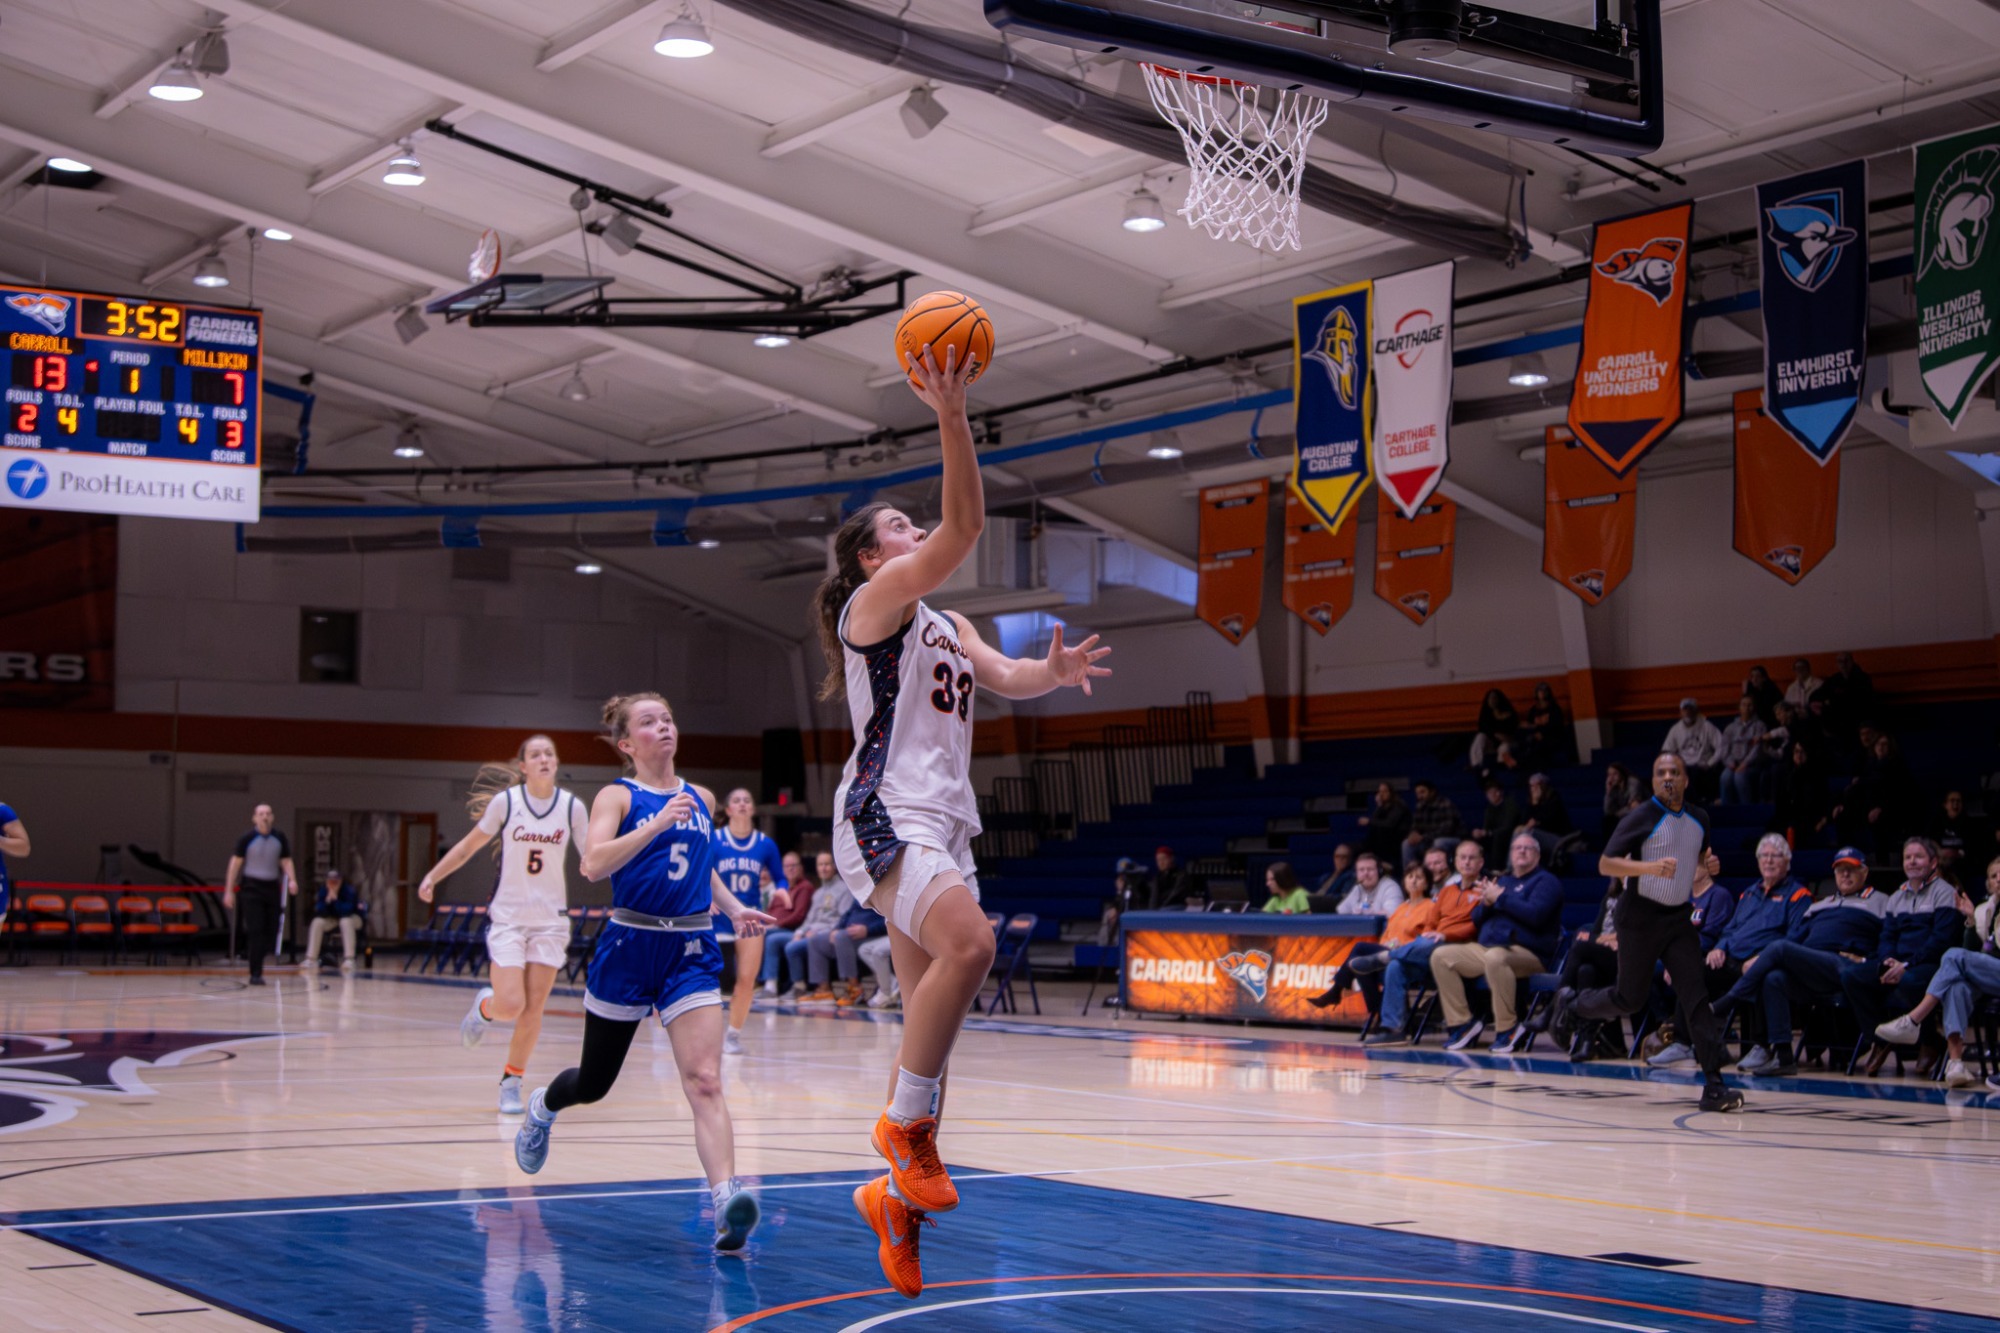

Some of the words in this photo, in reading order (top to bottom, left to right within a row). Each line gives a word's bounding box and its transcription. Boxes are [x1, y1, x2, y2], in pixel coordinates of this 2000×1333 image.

[1923, 289, 1981, 322] ILLINOIS
[107, 302, 180, 342] 3:52
[188, 316, 256, 333] CARROLL
[1919, 304, 1985, 340] WESLEYAN
[10, 333, 72, 354] CARROLL
[186, 328, 257, 346] PIONEERS
[1376, 324, 1444, 354] CARTHAGE
[110, 350, 150, 365] PERIOD
[1598, 350, 1656, 370] CARROLL
[1777, 349, 1854, 378] ELMHURST
[34, 356, 66, 391] 13
[130, 369, 140, 394] 1
[1584, 361, 1668, 385] UNIVERSITY
[6, 389, 43, 404] FOULS
[224, 372, 244, 405] 7
[1587, 377, 1659, 398] PIONEERS
[18, 404, 38, 432] 2
[94, 397, 136, 412] PLAYER
[138, 401, 166, 415] FOUL
[212, 406, 247, 421] FOULS
[57, 409, 78, 434] 4
[178, 418, 198, 444] 4
[4, 433, 41, 448] SCORE
[226, 421, 243, 447] 3
[1385, 424, 1436, 446] CARTHAGE
[108, 442, 147, 455] MATCH
[211, 450, 245, 464] SCORE
[1389, 440, 1430, 459] COLLEGE
[930, 661, 973, 722] 33
[513, 826, 564, 845] Carroll
[527, 850, 543, 875] 5
[668, 843, 689, 881] 5
[718, 858, 736, 873] BIG
[730, 874, 751, 892] 10
[1130, 957, 1217, 984] CARROLL
[1272, 963, 1341, 991] PIONE
